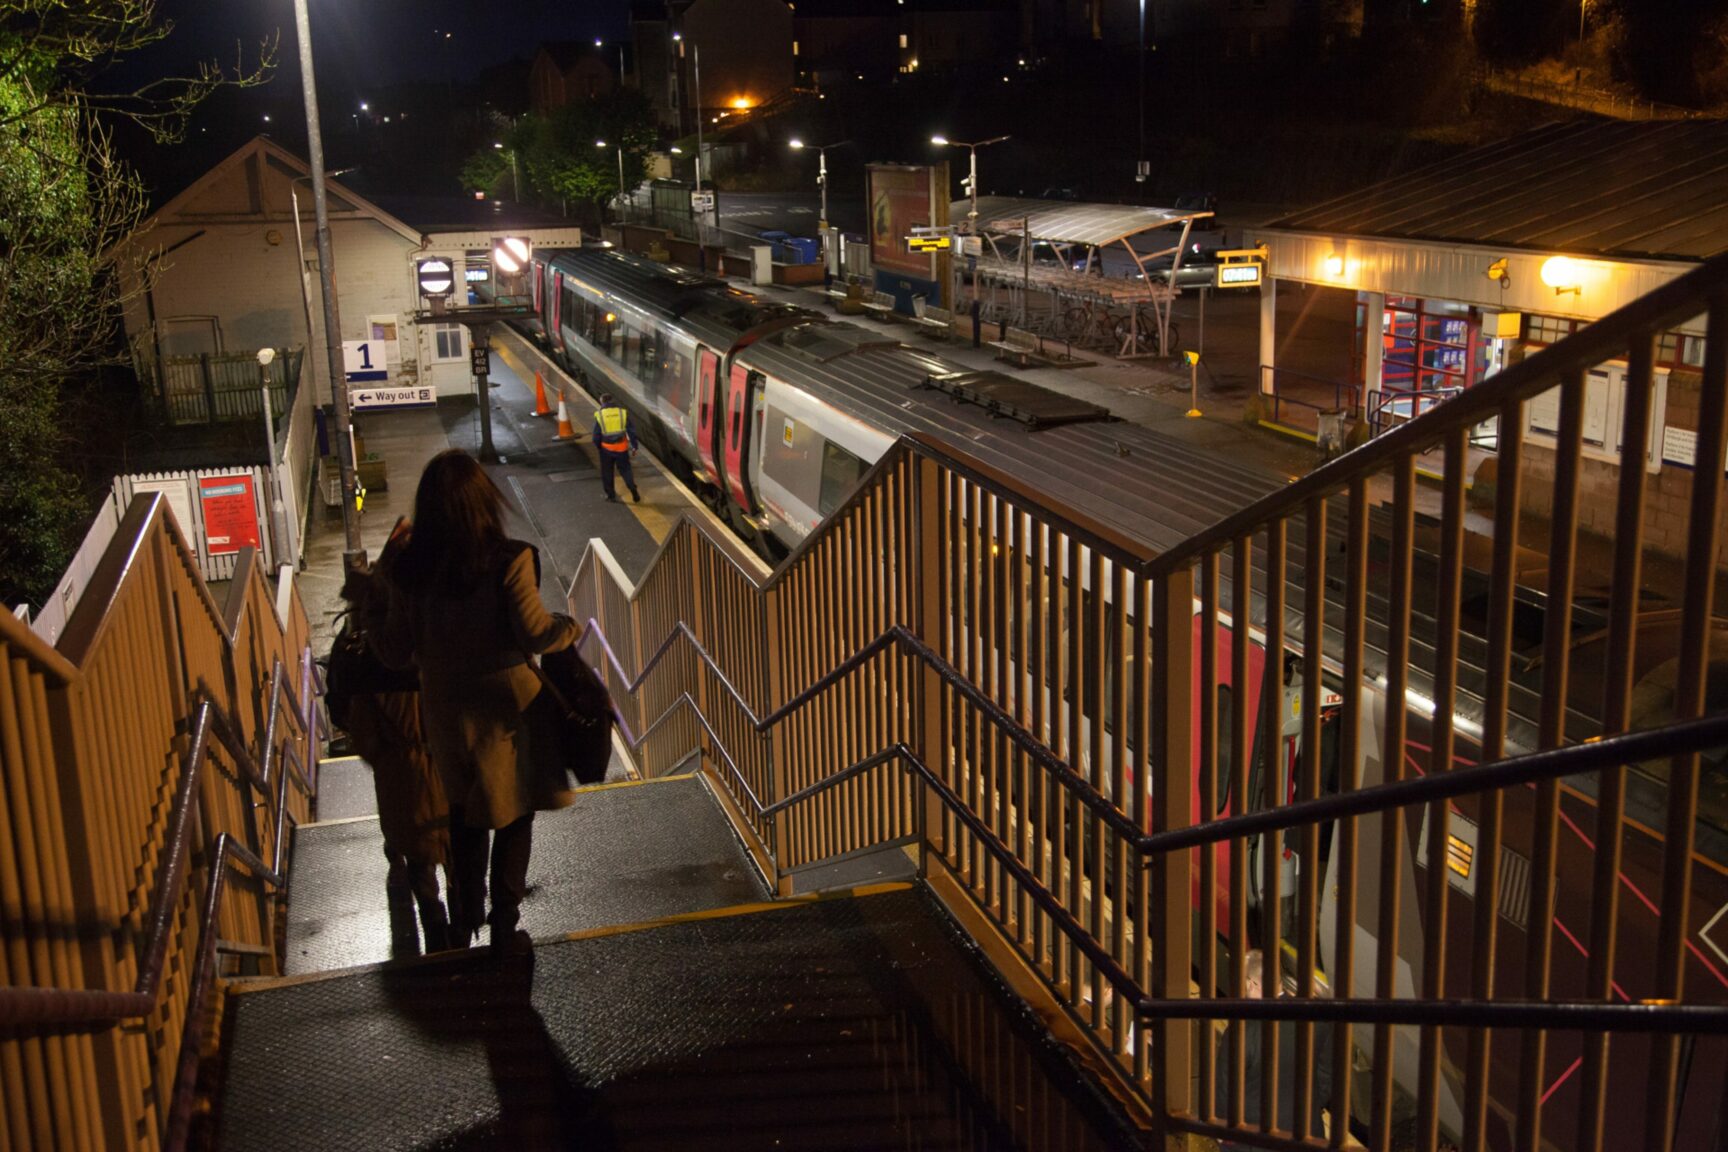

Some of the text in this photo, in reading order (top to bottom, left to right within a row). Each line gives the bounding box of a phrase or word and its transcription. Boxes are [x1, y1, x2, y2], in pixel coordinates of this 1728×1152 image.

[357, 343, 373, 369] 1
[474, 349, 485, 357] EV
[375, 391, 415, 402] Way out
